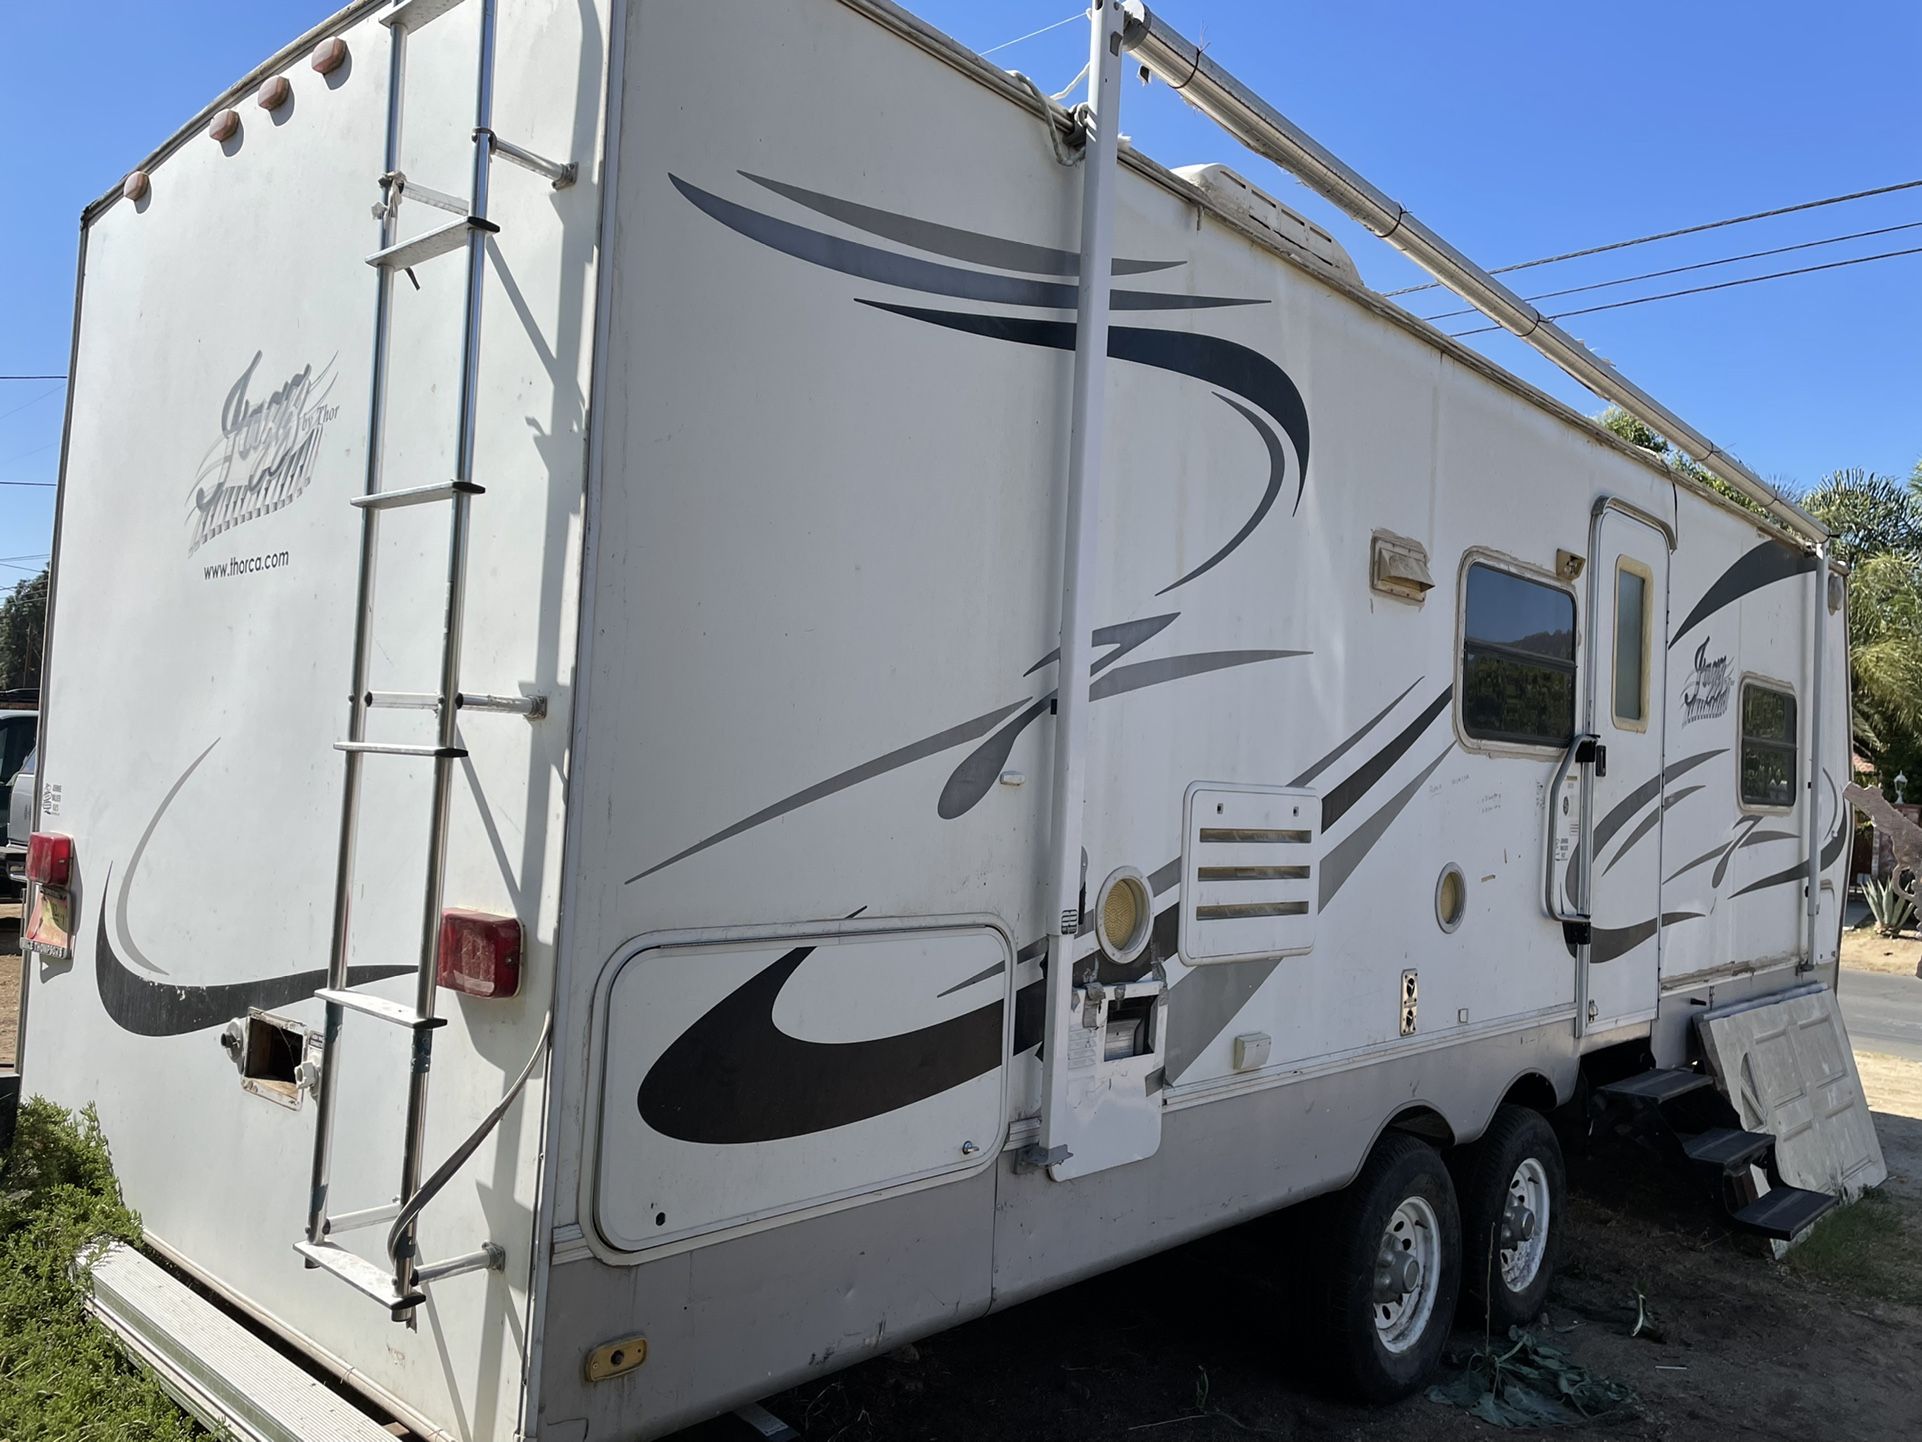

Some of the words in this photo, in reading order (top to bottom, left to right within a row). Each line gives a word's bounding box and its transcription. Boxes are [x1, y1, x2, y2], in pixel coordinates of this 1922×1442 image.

[302, 414, 314, 432] by
[316, 405, 340, 427] Thor
[203, 549, 290, 580] www.thorca.com
